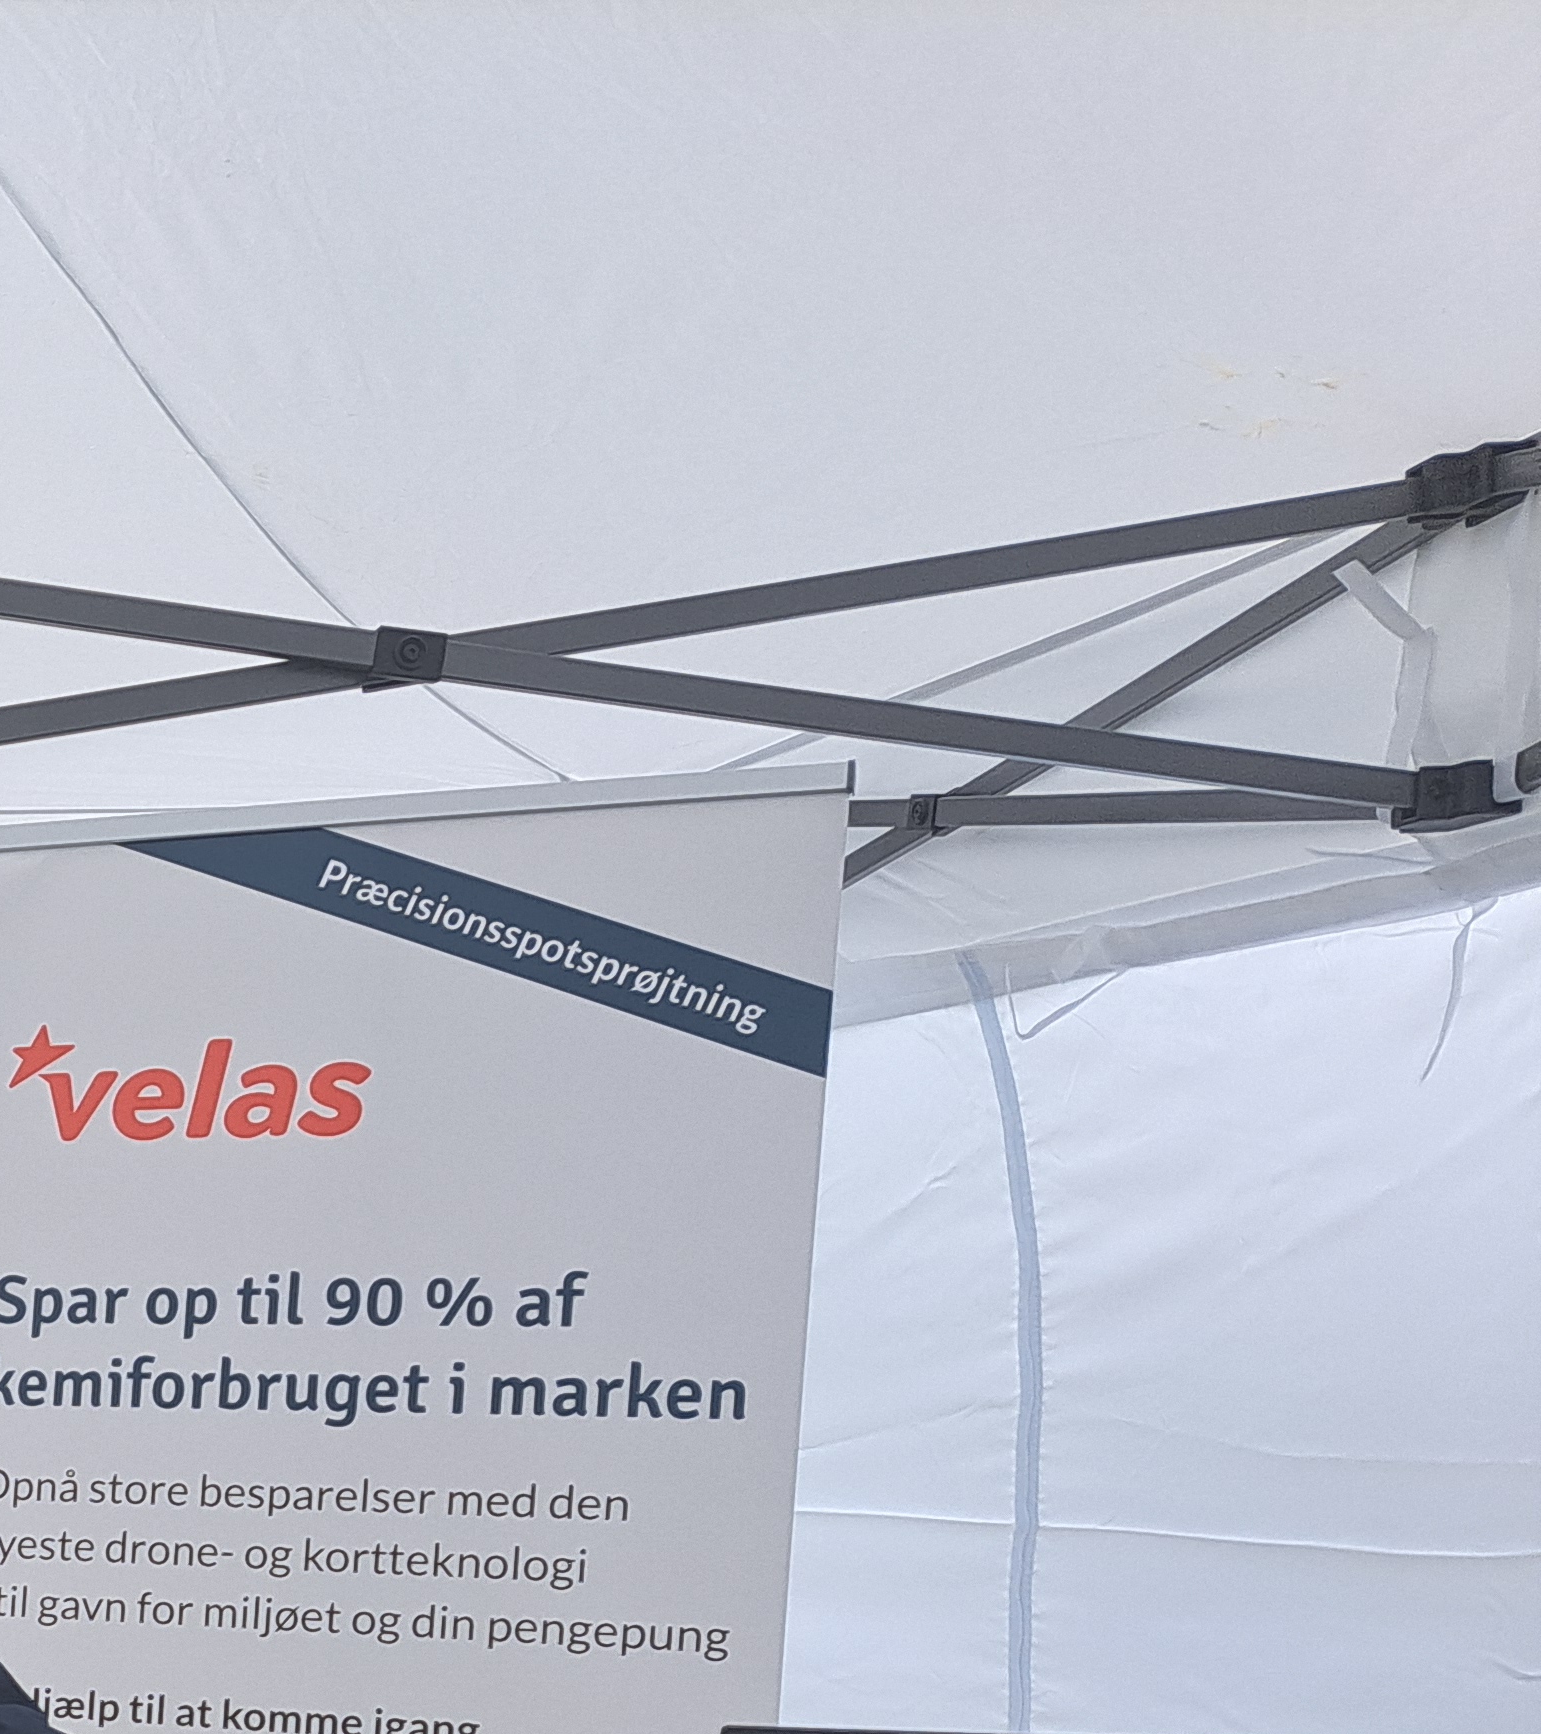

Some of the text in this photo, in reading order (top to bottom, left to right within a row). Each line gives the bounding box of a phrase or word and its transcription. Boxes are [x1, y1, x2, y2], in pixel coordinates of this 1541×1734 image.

[318, 858, 766, 1035] Præcisionsspotsprøjtning
[37, 1038, 372, 1141] velas
[145, 1287, 218, 1340] op
[236, 1270, 304, 1326] til
[326, 1277, 403, 1327] 90
[426, 1277, 493, 1327] %
[515, 1270, 589, 1328] af
[449, 1361, 466, 1415] i
[489, 1361, 746, 1421] marken
[89, 1474, 189, 1507] store
[200, 1473, 436, 1517] besparelser
[447, 1482, 537, 1518] med
[549, 1484, 629, 1522] den
[105, 1530, 234, 1568] drone-
[244, 1545, 293, 1578] og
[303, 1537, 587, 1591] kortteknologi
[37, 1595, 126, 1627] gavn
[137, 1591, 194, 1626] for
[204, 1595, 341, 1638] miljøet
[351, 1611, 402, 1646] og
[411, 1604, 475, 1641] din
[487, 1617, 730, 1663] pengepung
[30, 1687, 120, 1727] jælp
[129, 1693, 165, 1725] til
[175, 1700, 212, 1729] at
